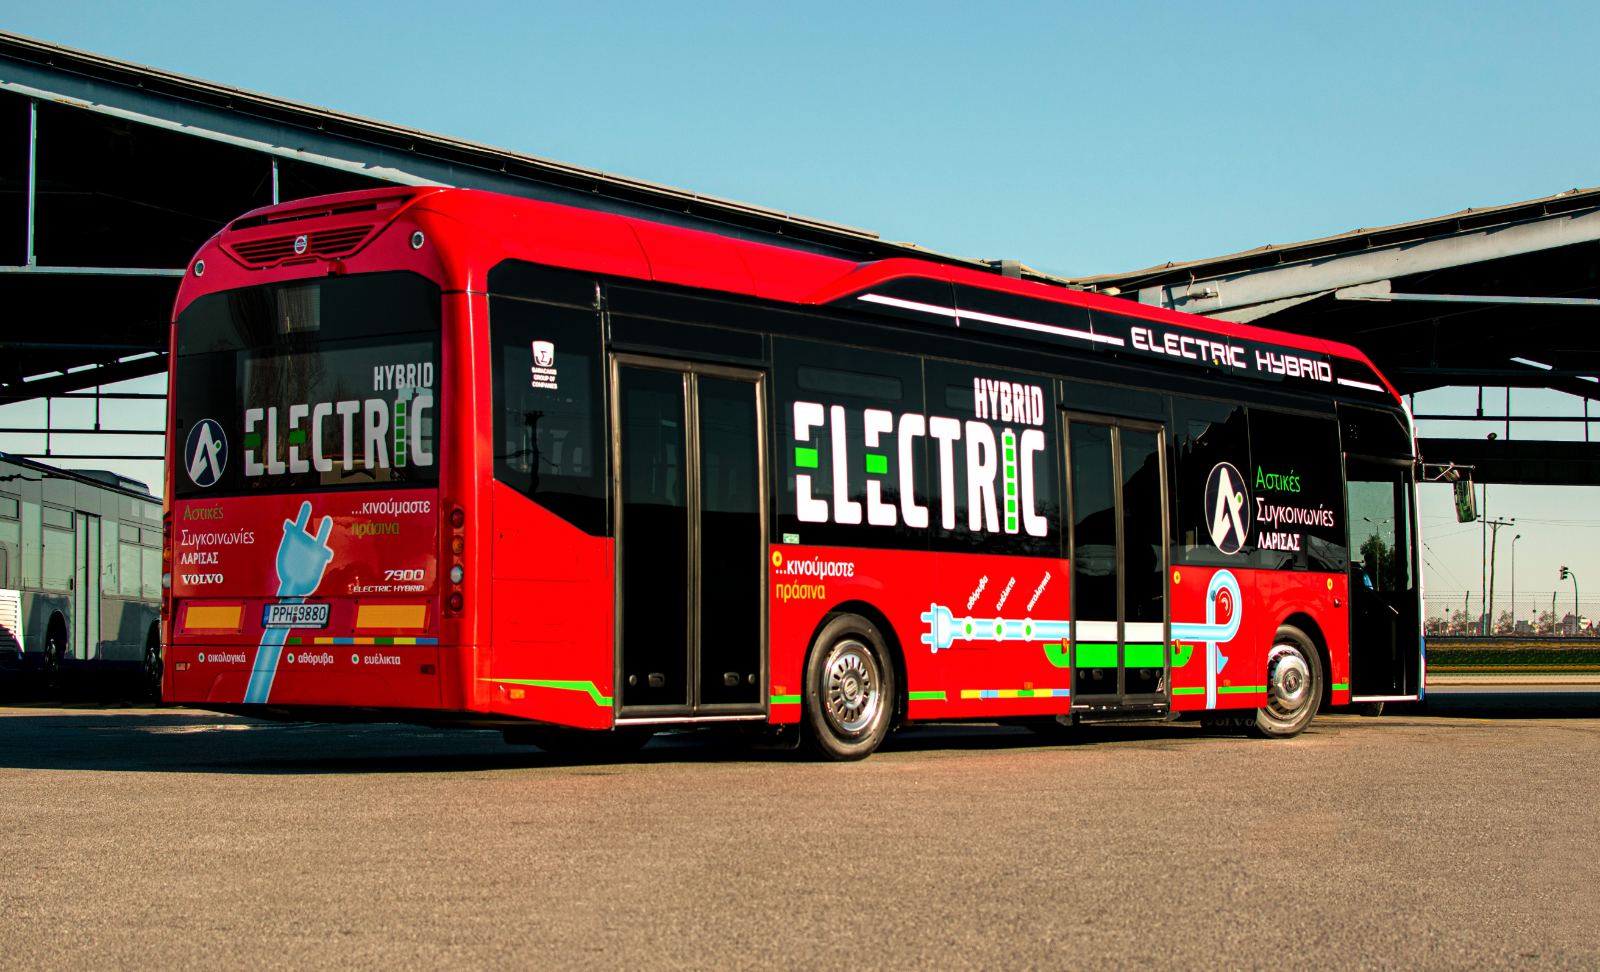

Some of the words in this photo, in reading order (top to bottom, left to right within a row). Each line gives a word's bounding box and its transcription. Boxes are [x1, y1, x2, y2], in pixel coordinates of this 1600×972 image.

[1131, 327, 1246, 369] ELECTRIC
[1256, 350, 1332, 382] HYBRID
[374, 362, 433, 390] HYBRID
[532, 381, 558, 389] COMPANIES
[973, 377, 1045, 426] HYBRID
[244, 395, 433, 477] ELECTRIC
[793, 400, 1048, 538] ELECTRIC
[1255, 465, 1301, 493] Αστικές
[183, 503, 224, 521] Αστικές
[1255, 497, 1334, 529] Συγκοινωνίες
[181, 528, 255, 550] Συγκοινωνίες
[351, 520, 399, 539] πράσινα
[1257, 532, 1300, 552] ΛΑΡΙΣΑΣ
[181, 552, 219, 565] ΛΑΡΙΣΑΣ
[181, 573, 224, 585] VOLVO
[384, 569, 425, 581] 7900
[353, 585, 392, 593] ELECTRIC
[393, 584, 425, 593] HYBRID
[776, 579, 825, 603] πράσινα
[207, 651, 246, 665] οικολογικά
[298, 653, 334, 666] αθόρυβα
[364, 654, 401, 665] ευέλικτα
